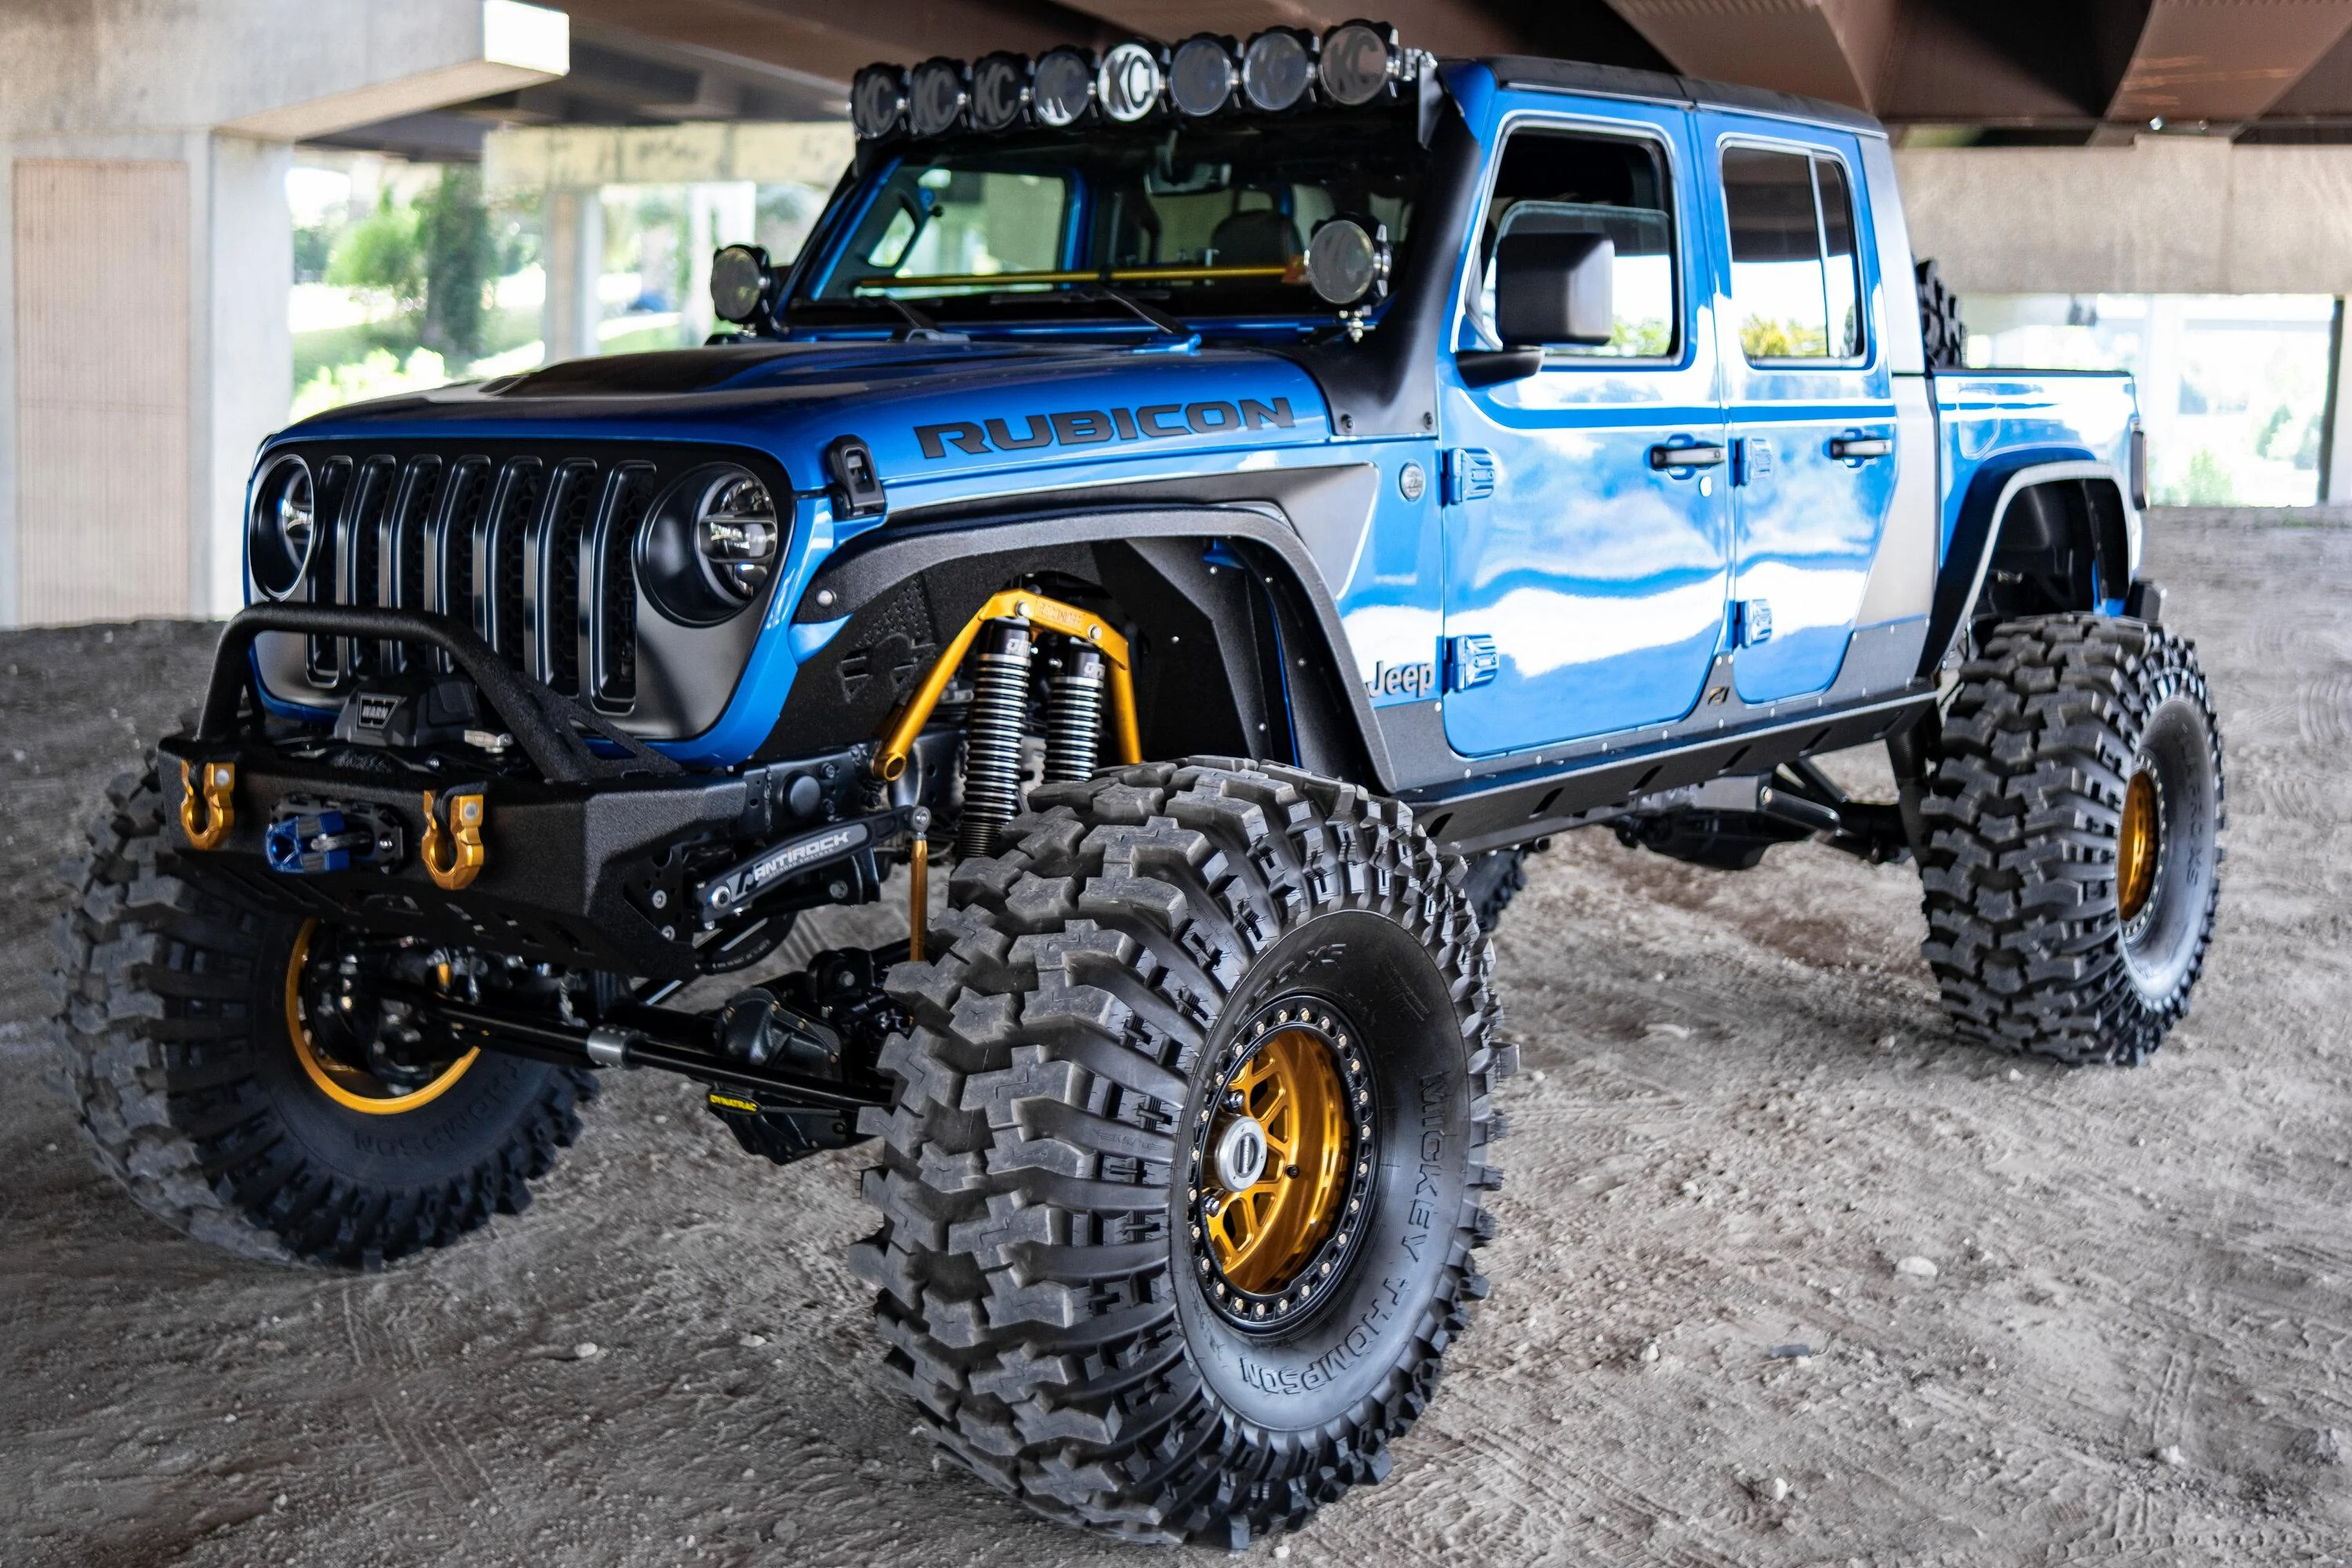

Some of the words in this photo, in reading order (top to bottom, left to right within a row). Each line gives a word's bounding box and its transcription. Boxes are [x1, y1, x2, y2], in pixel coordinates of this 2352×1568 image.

[1107, 52, 1151, 114] KC
[1334, 33, 1378, 91] KC
[857, 74, 892, 125] KC
[913, 67, 950, 122] KC
[977, 63, 1015, 123] KC
[913, 397, 1296, 459] RUBICON
[1366, 660, 1436, 698] Jeep
[362, 705, 388, 719] WARN
[710, 1094, 758, 1113] DYNATRAC
[1402, 1072, 1445, 1263] MICKEY
[1239, 1278, 1408, 1395] THOMPSON
